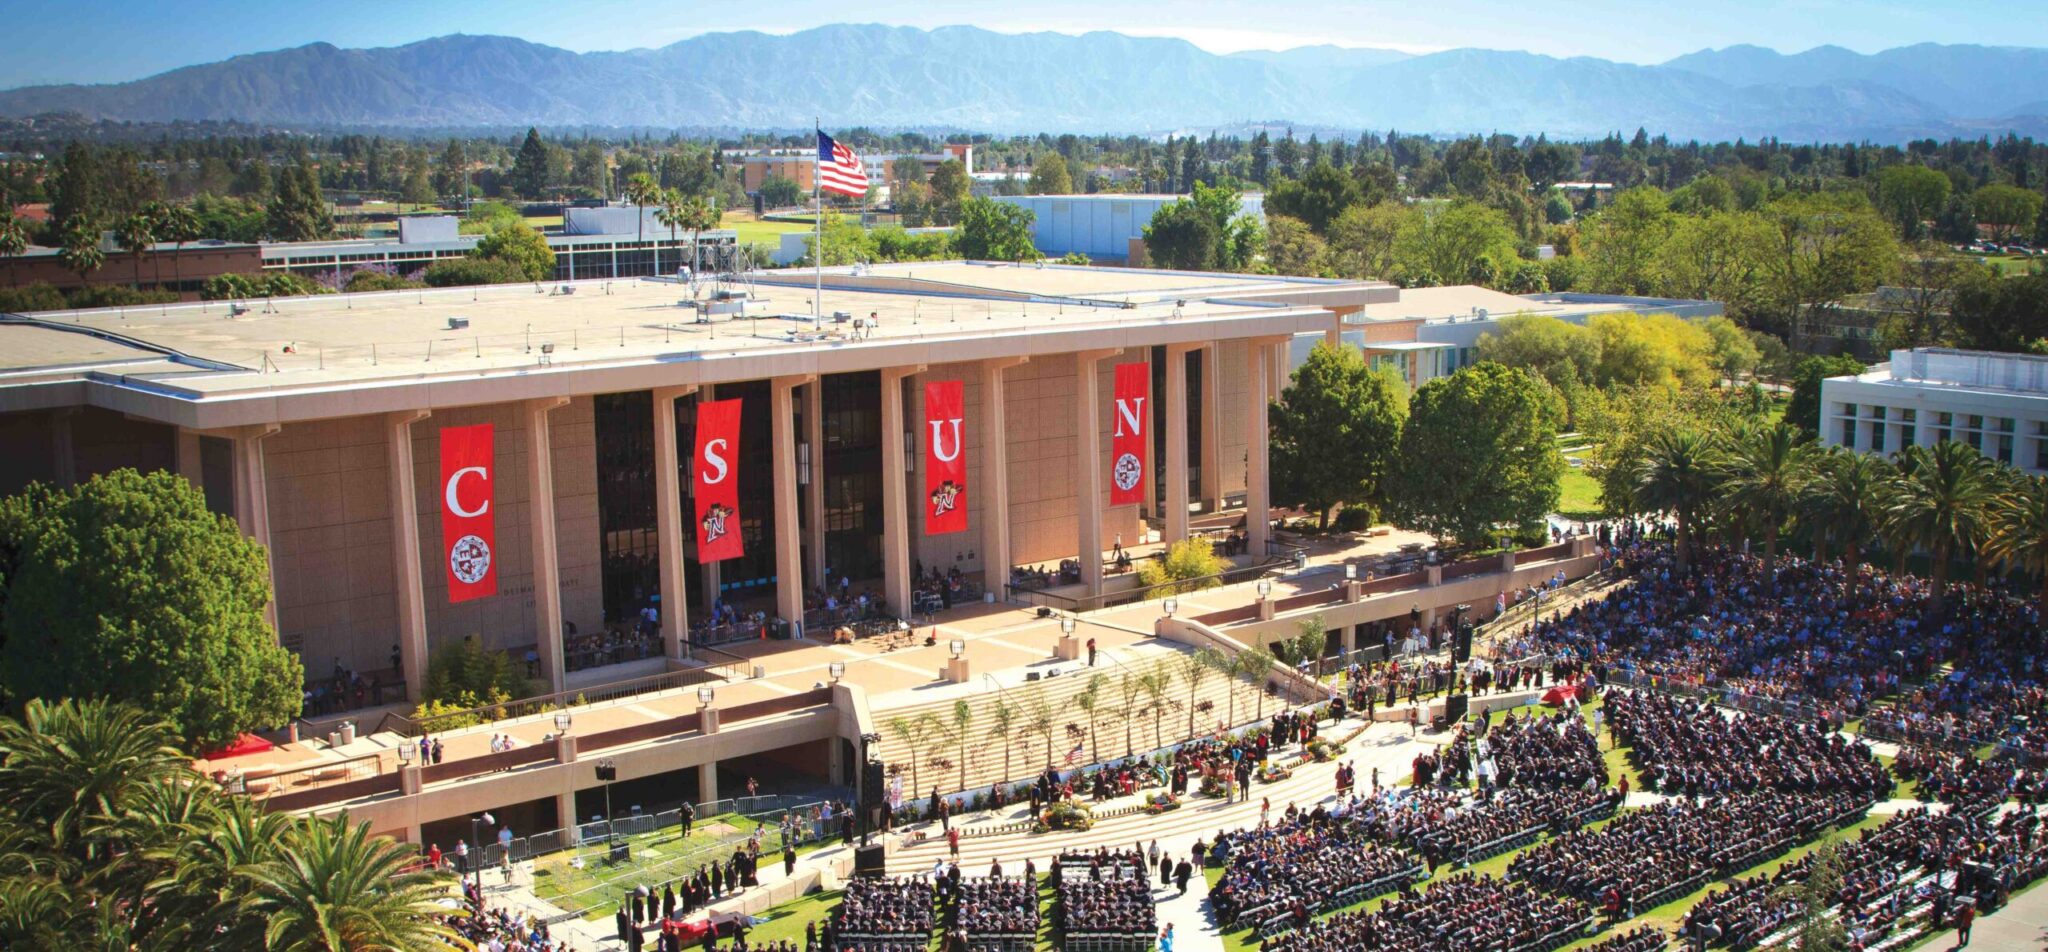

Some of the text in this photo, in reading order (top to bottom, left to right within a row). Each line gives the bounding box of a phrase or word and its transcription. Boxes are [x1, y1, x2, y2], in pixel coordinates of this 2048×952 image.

[1115, 397, 1145, 437] N
[703, 438, 728, 484] S
[929, 418, 963, 463] U
[446, 466, 489, 518] C
